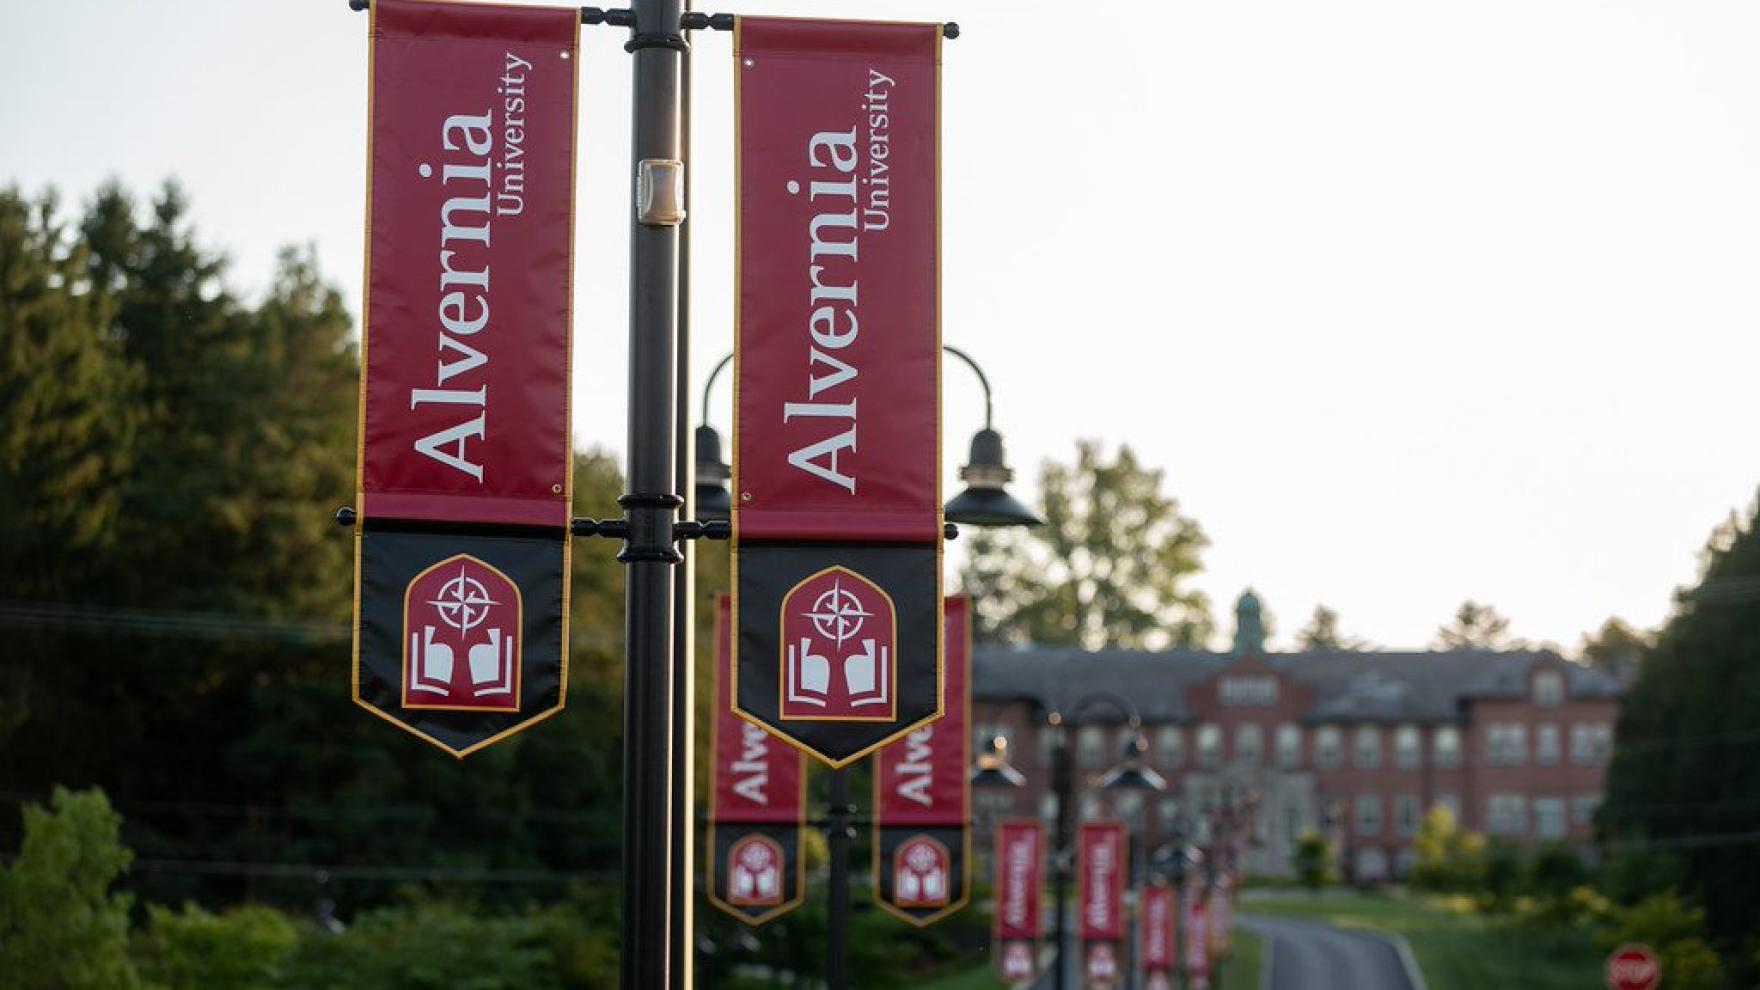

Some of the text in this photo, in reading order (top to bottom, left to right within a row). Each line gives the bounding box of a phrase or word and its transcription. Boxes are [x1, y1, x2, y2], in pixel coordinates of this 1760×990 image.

[497, 52, 532, 217] University
[864, 69, 895, 232] University
[411, 109, 492, 484] Alvernia
[784, 126, 858, 495] Alvernia
